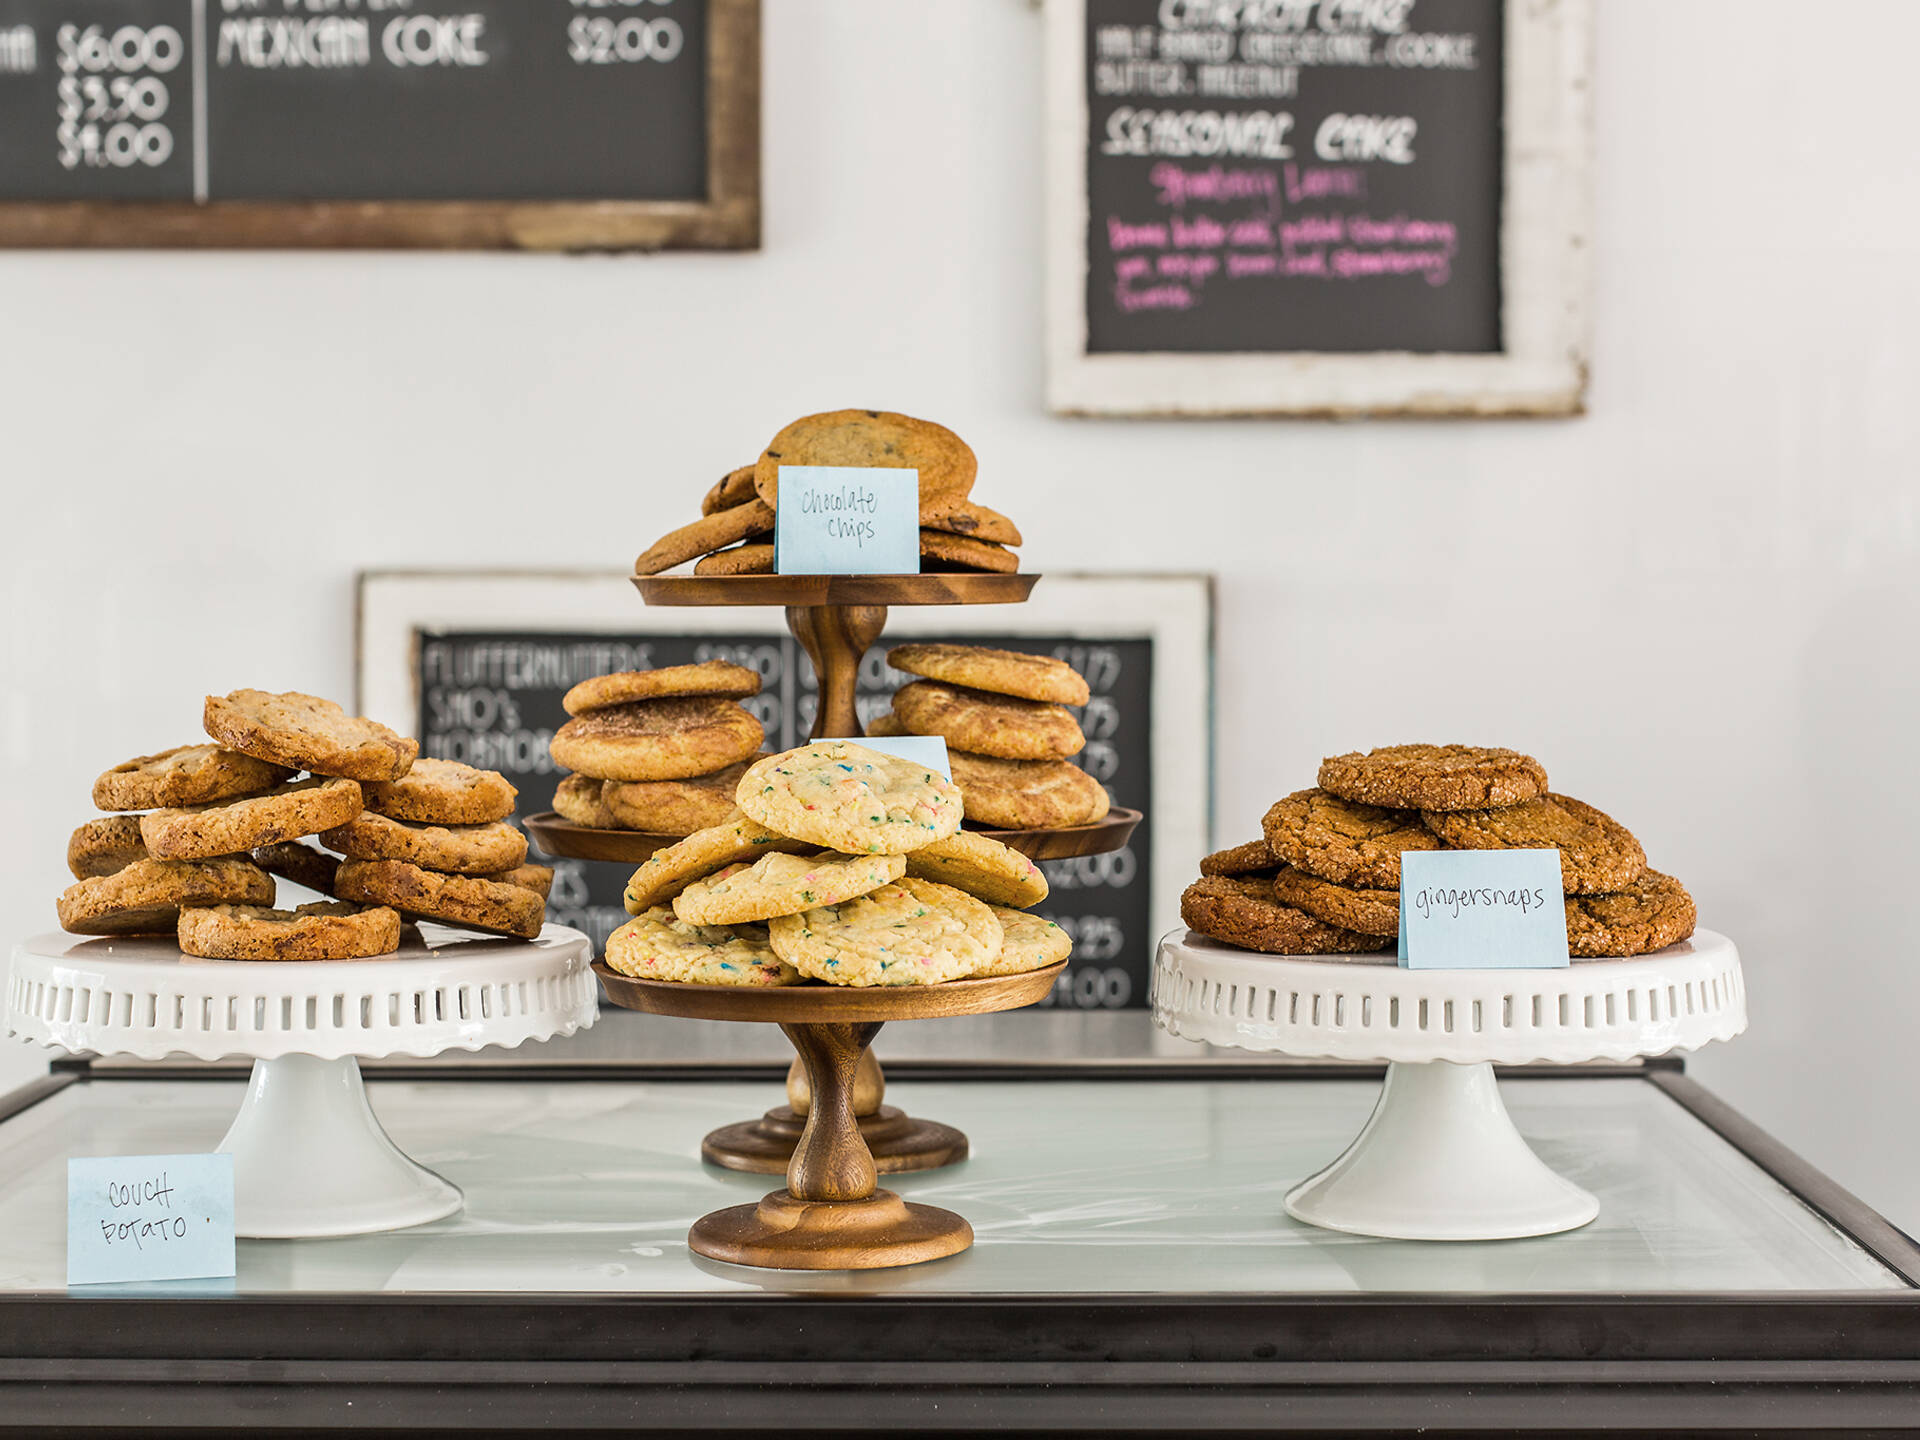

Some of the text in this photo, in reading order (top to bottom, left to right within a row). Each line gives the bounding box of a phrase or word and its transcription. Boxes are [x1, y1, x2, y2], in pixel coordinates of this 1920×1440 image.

[382, 14, 490, 67] COKE
[1102, 106, 1418, 164] SEASONAL CAKE
[801, 485, 878, 514] chocolate
[827, 517, 876, 549] chips
[1415, 887, 1545, 919] gingersnaps
[109, 1171, 174, 1209] COUCH
